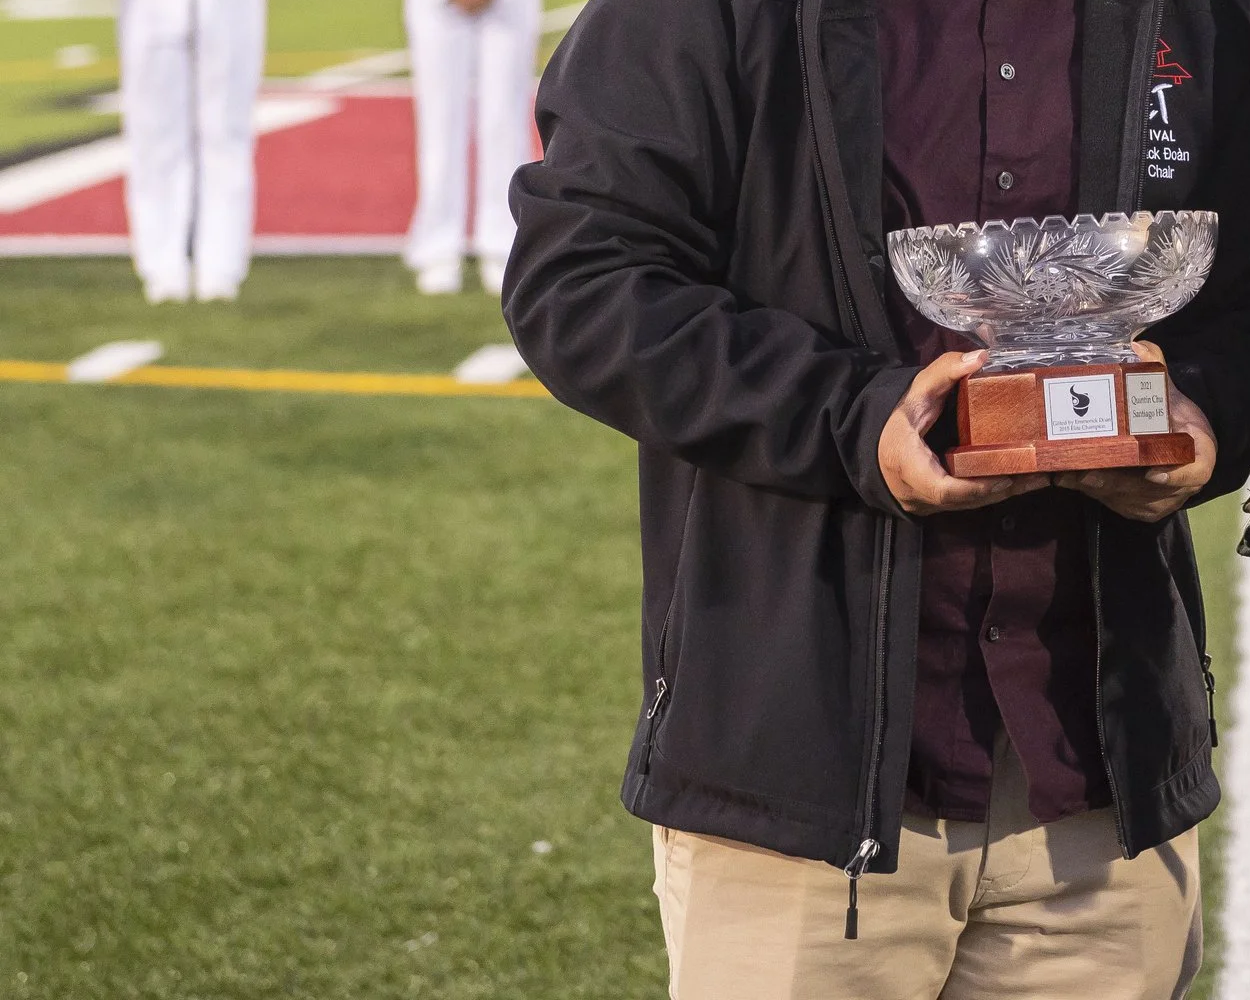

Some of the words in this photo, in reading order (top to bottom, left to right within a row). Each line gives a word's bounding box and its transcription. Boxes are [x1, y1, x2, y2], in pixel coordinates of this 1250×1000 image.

[1147, 147, 1161, 160] ck
[1148, 164, 1175, 179] Chair
[1133, 409, 1155, 419] Santiago
